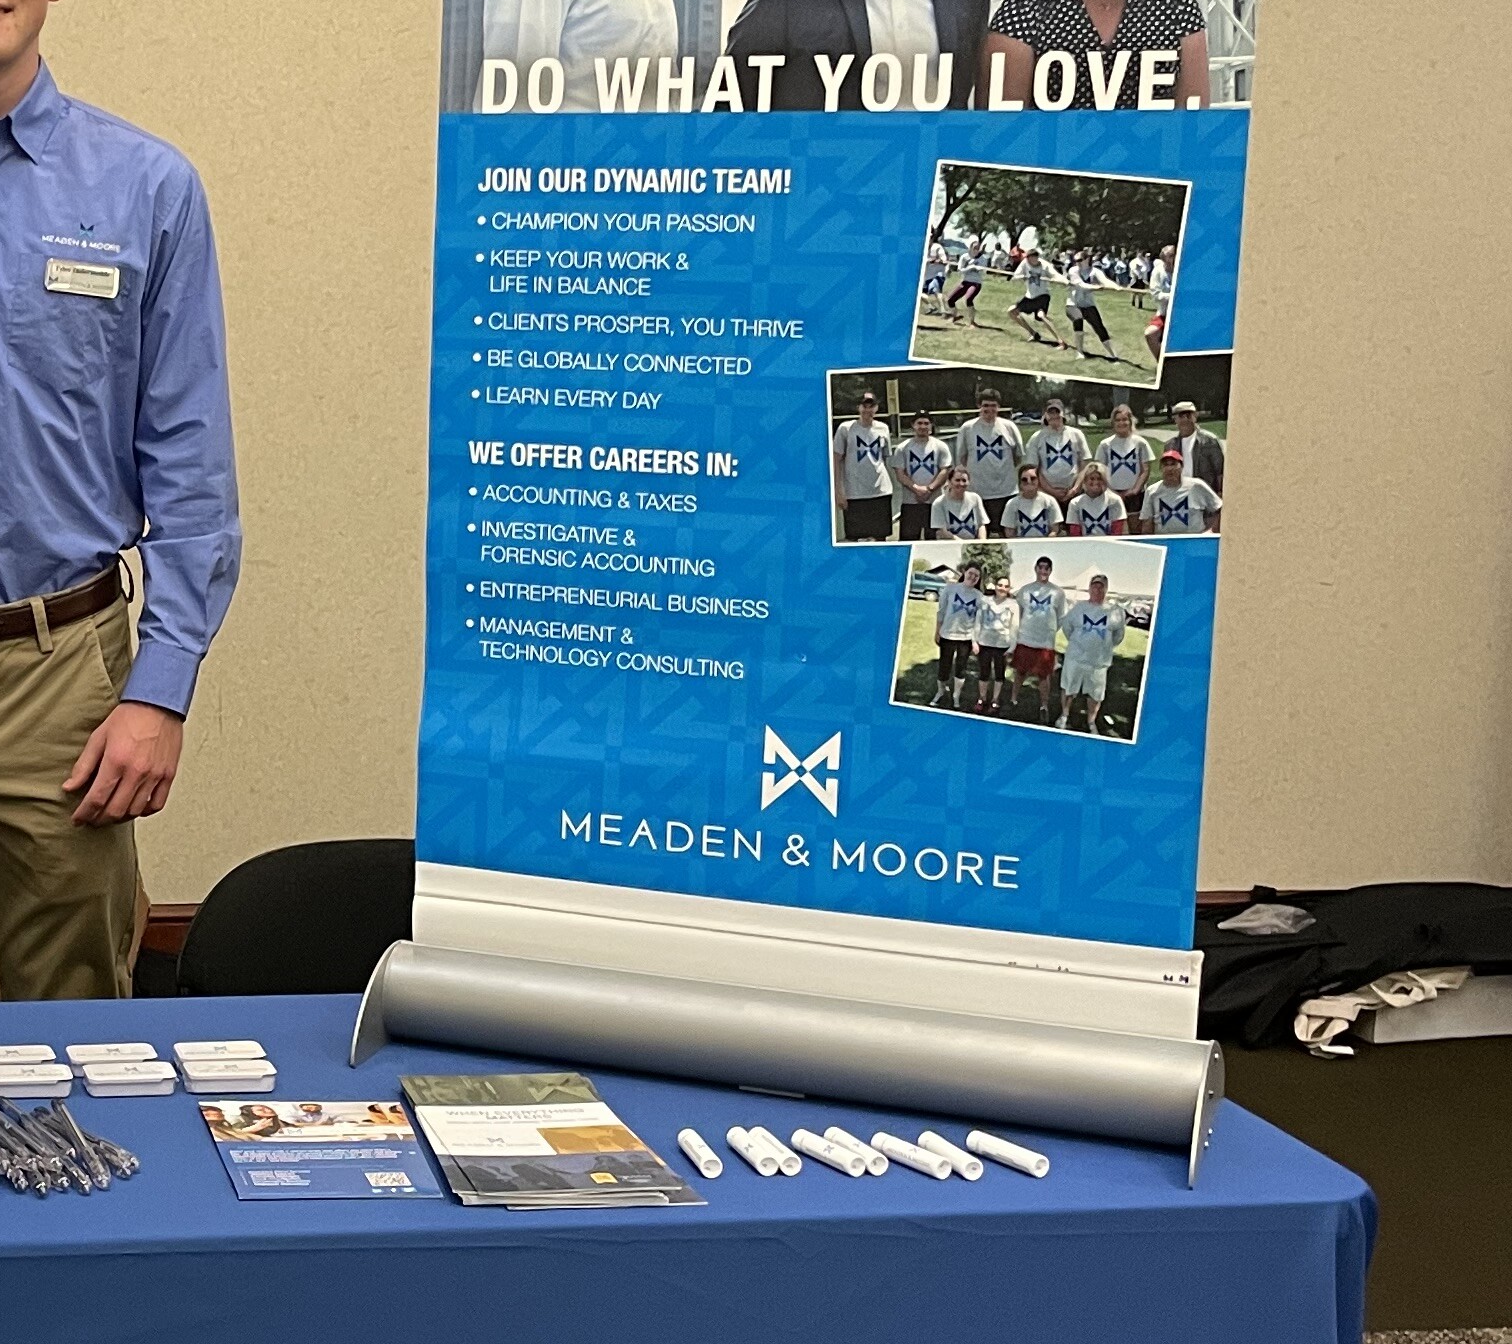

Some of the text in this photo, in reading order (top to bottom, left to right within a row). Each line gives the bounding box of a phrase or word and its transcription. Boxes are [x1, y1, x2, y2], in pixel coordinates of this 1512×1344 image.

[481, 50, 1202, 115] DO WHAT YOU LOVE.
[477, 167, 791, 195] JOIN OUR DYNAMIC TEAM!
[492, 212, 755, 233] CHAMPION YOUR PASSION
[42, 235, 120, 253] MEADEN & MOORE
[490, 250, 689, 270] KEEP YOUR WORK &
[490, 276, 651, 296] LIFE IN BALANCE
[488, 313, 803, 338] CLIENTS PROSPER, YOU THRIVE
[488, 350, 751, 375] BE GLOBALLY CONNECTED
[486, 387, 662, 409] LEARN EVERY DAY
[469, 441, 738, 476] WE OFFER CAREERS IN:
[483, 485, 697, 512] ACCOUNTING & TAXES
[481, 521, 636, 546] INVESTIGATIVE &
[481, 545, 715, 577] FORENSIC ACCOUNTING
[480, 581, 769, 618] ENTREPRENEURIAL BUSINESS
[480, 617, 633, 644] MANAGEMENT &
[479, 641, 744, 679] TECHNOLOGY CONSULTING
[560, 810, 1019, 889] MEADEN & MOORE
